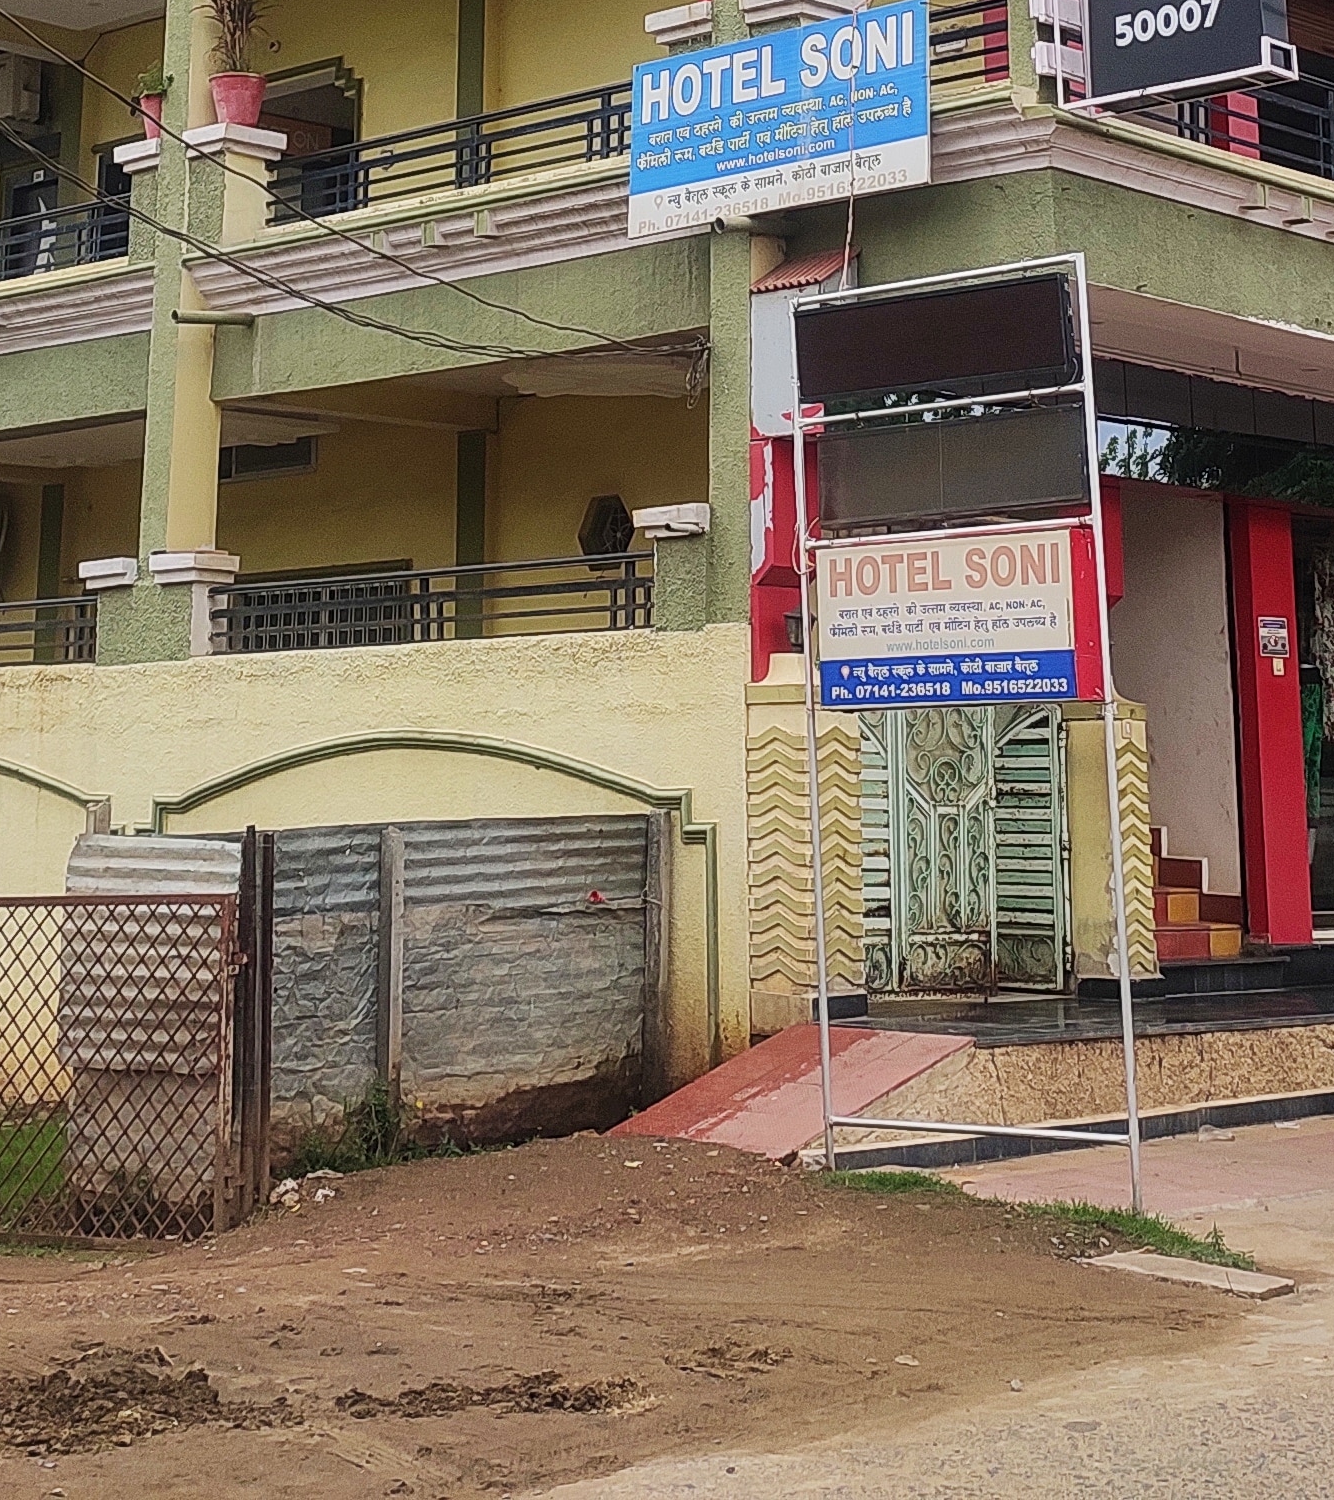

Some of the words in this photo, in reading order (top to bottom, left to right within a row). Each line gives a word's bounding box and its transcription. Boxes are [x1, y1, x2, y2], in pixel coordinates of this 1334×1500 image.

[641, 45, 786, 125] HOTEL
[800, 11, 914, 88] SONI
[902, 97, 912, 117] है
[716, 139, 835, 172] www.hotelsoni.com
[740, 176, 750, 192] के
[638, 220, 660, 234] Ph.
[829, 551, 952, 597] HOTEL
[965, 543, 1060, 589] SONI
[905, 602, 917, 616] की
[989, 601, 1003, 612] AC,
[1030, 599, 1045, 610] AC,
[905, 619, 924, 634] पार्टी
[1049, 612, 1057, 628] है
[886, 637, 995, 652] www.hotelsoni.com
[916, 660, 926, 676] के
[831, 686, 852, 700] Ph.
[855, 682, 951, 699] 07141-236518
[961, 678, 1068, 695] Mo.9516522033
